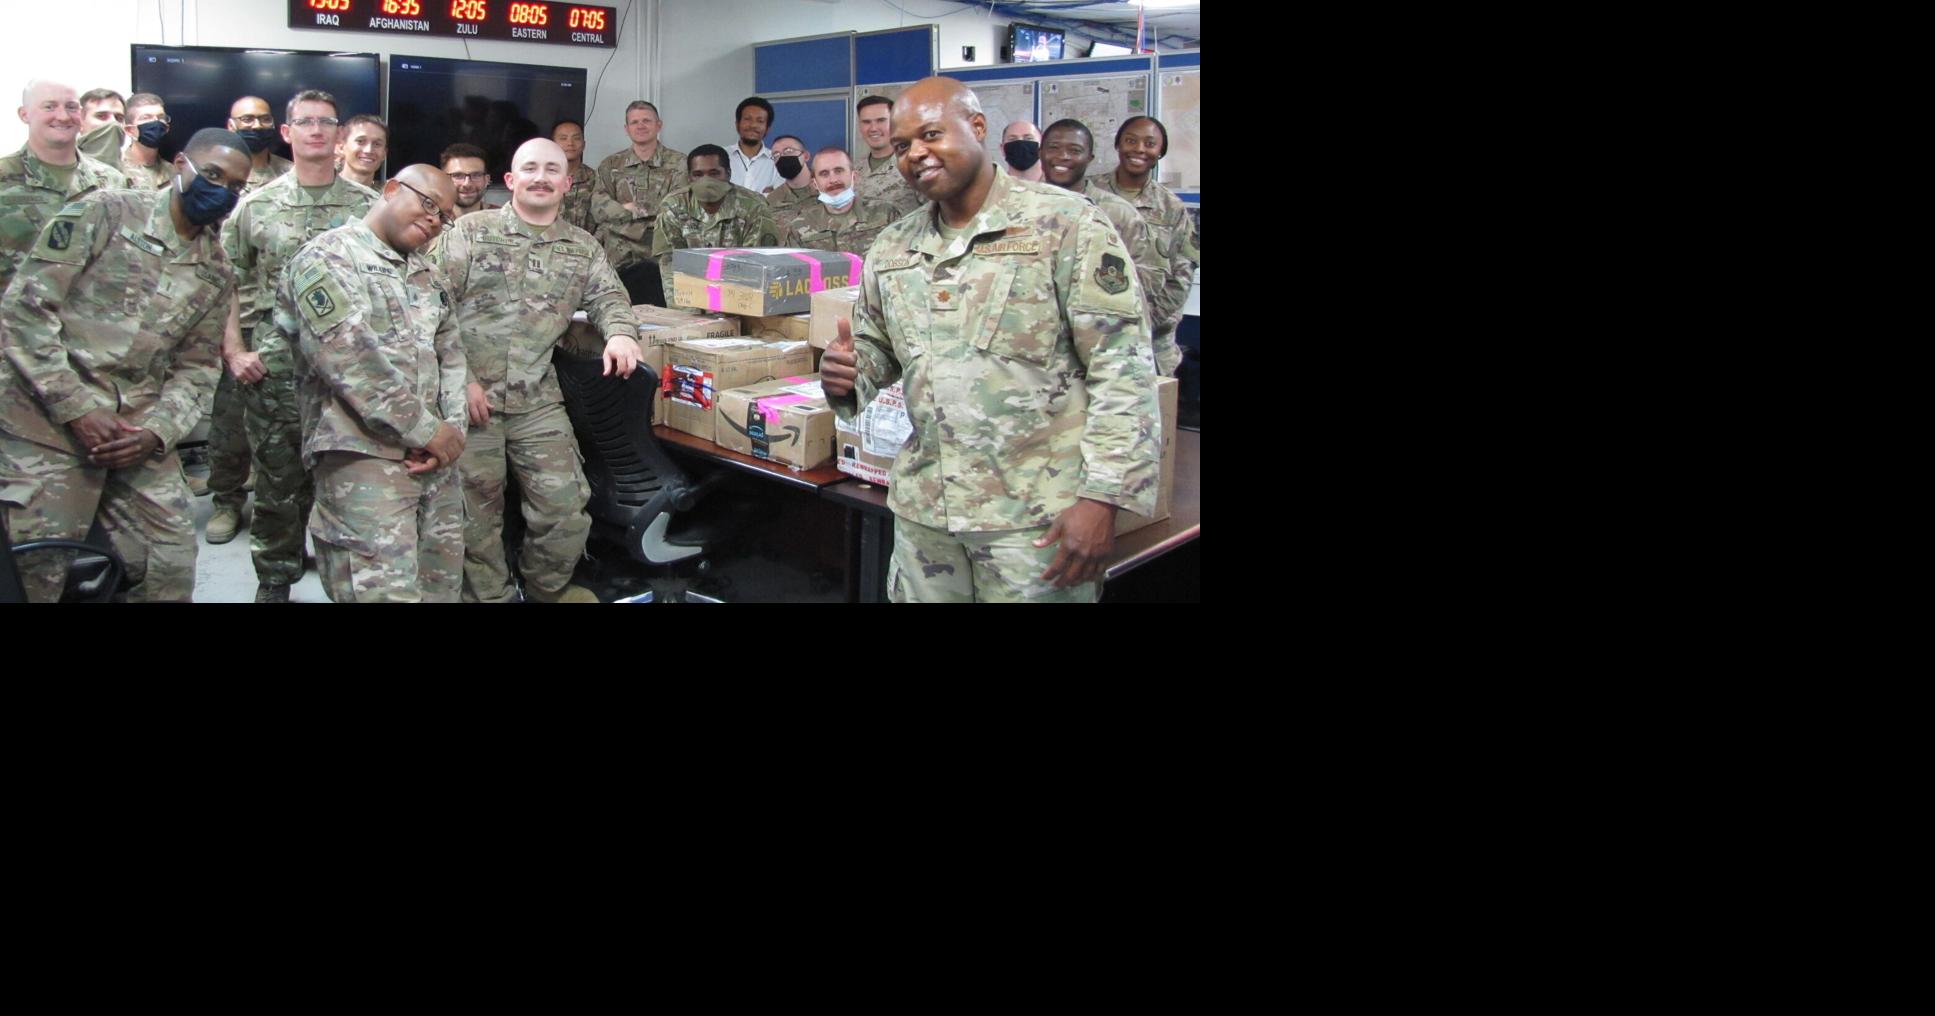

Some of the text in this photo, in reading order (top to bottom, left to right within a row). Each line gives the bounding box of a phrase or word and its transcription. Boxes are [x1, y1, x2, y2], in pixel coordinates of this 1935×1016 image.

[452, 0, 486, 20] 12:05
[510, 3, 547, 25] 08:05
[316, 13, 340, 26] IRAQ
[369, 17, 430, 31] AFGHANISTAN
[569, 8, 604, 29] 07:05
[456, 23, 478, 35] ZULU
[511, 27, 547, 40] EASTERN
[571, 32, 604, 44] CENTRAL
[786, 275, 849, 296] LACOSS
[707, 329, 734, 339] FRAGILE
